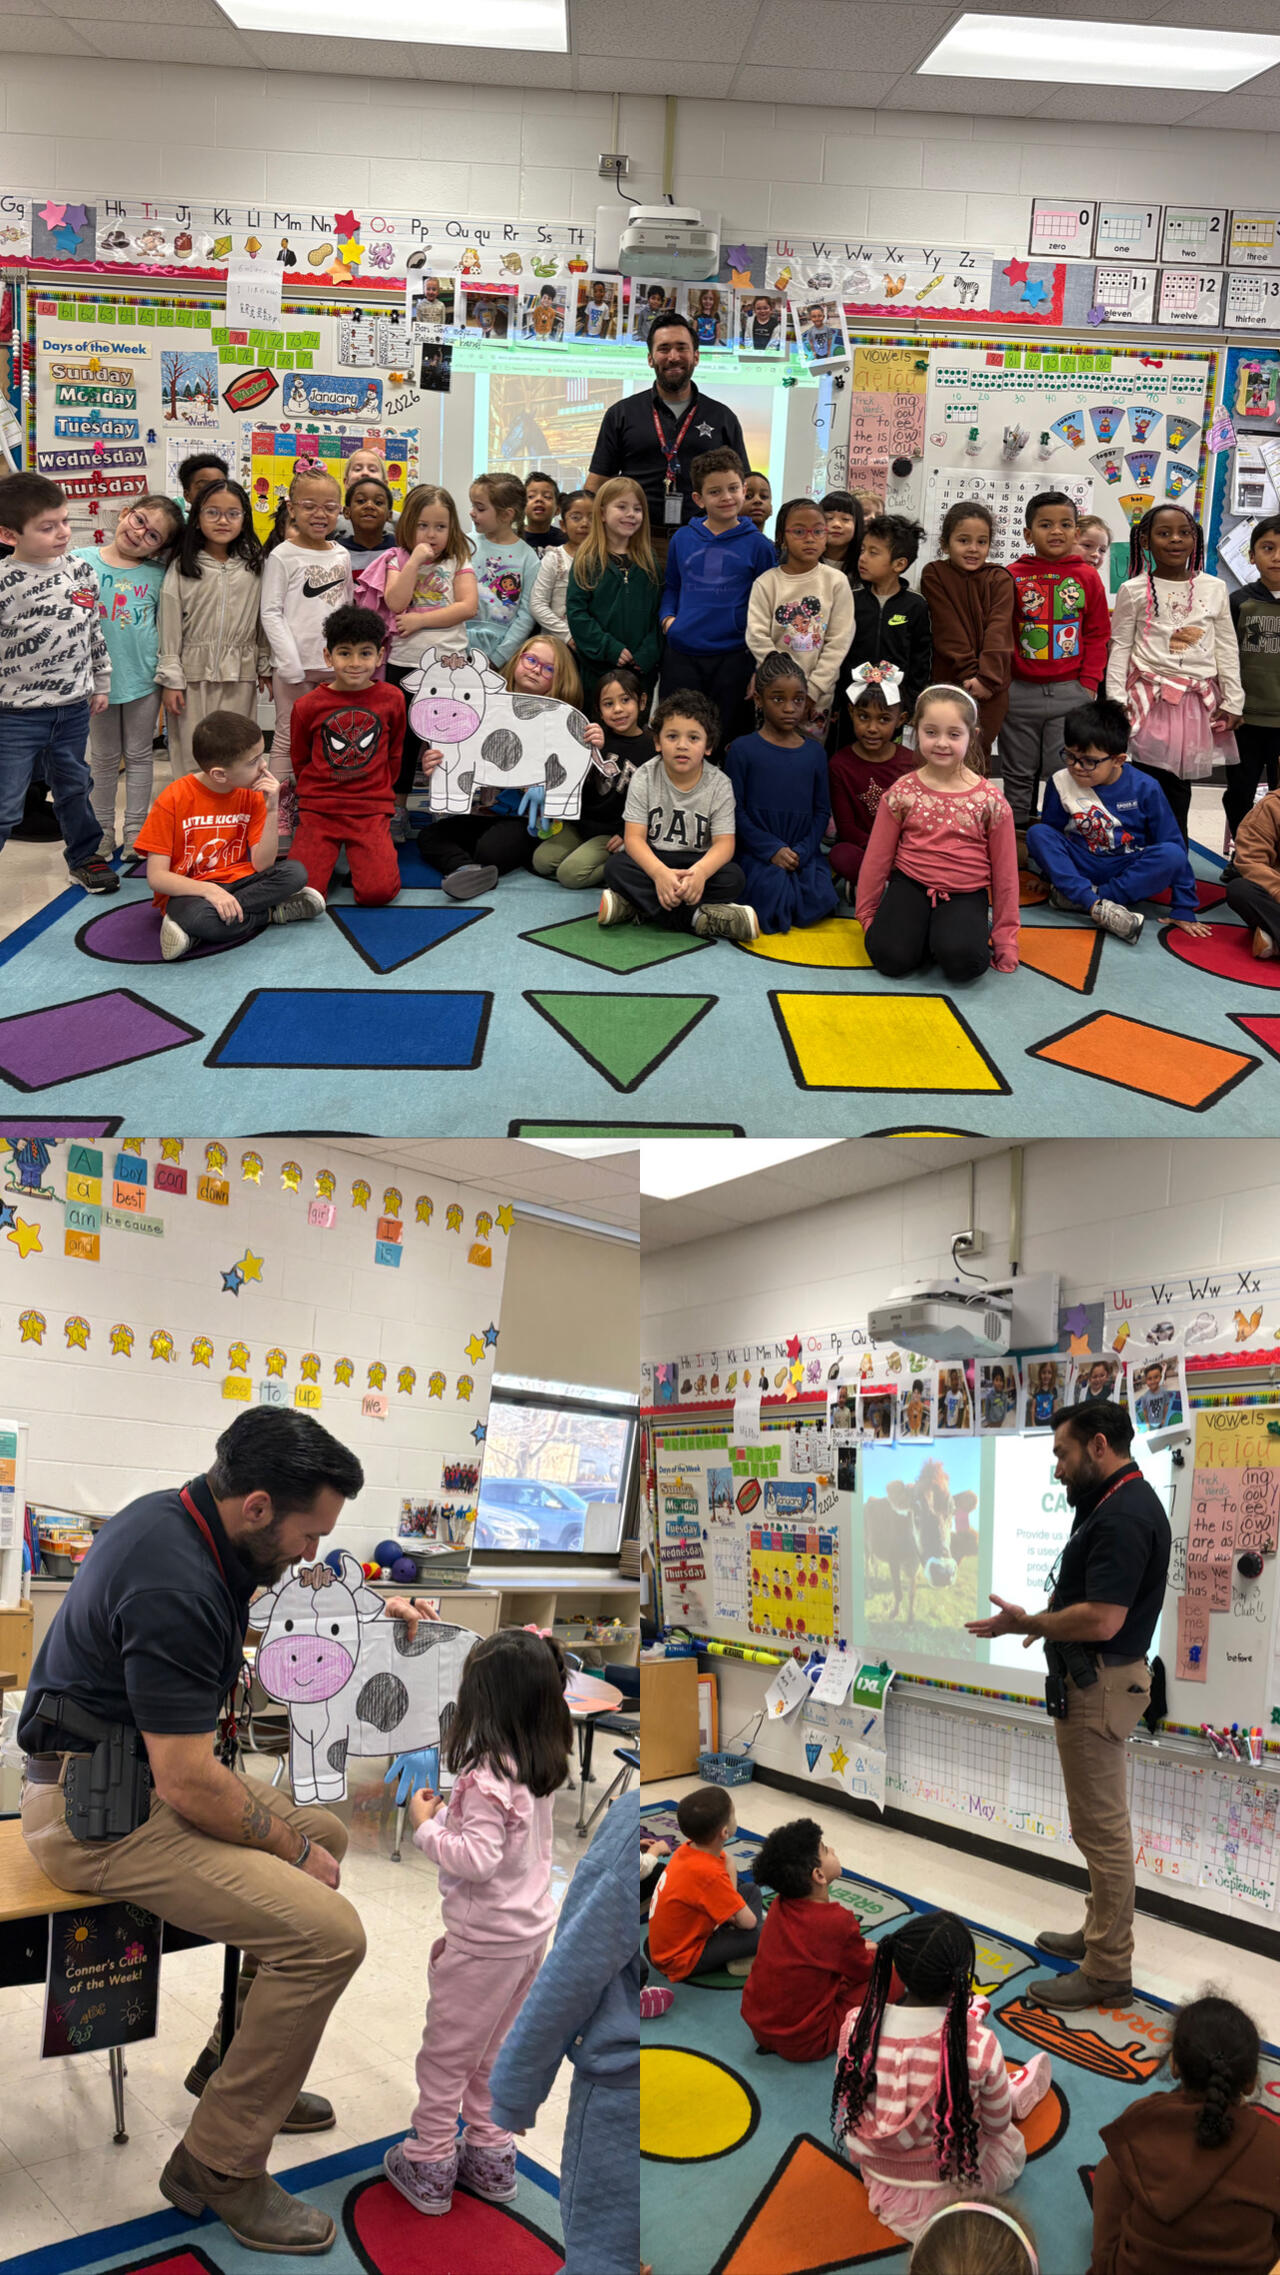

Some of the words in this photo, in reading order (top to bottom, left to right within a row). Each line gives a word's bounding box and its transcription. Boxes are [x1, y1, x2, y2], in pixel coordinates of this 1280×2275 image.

[1, 196, 24, 220] Gg
[106, 200, 126, 217] Hh
[141, 203, 157, 219] Ii
[176, 205, 191, 230] Jj
[214, 208, 232, 225] Kk
[248, 211, 260, 228] Ll
[274, 213, 302, 230] Mm
[312, 215, 331, 232] Nn
[1079, 210, 1090, 226] 0
[1146, 213, 1153, 228] 1
[370, 216, 395, 234] Oo
[411, 218, 429, 242] Pp
[503, 224, 519, 241] Rr
[537, 226, 552, 243] Ss
[568, 228, 585, 245] Tt
[1209, 217, 1220, 232] 2
[1048, 242, 1067, 250] zero
[776, 240, 794, 257] Uu
[812, 242, 831, 259] Vv
[845, 244, 872, 260] Ww
[885, 247, 904, 263] Xx
[922, 249, 941, 272] Yy
[959, 252, 975, 268] Zz
[1247, 252, 1268, 261] three
[1132, 277, 1147, 291] 11
[1199, 278, 1216, 293] 12
[1263, 282, 1280, 297] 13
[1104, 310, 1132, 318] eleven
[1170, 312, 1198, 320] twelve
[1235, 315, 1267, 324] thirteen
[43, 341, 73, 352] Days
[75, 341, 89, 351] of
[90, 343, 110, 352] the
[111, 343, 146, 354] Week
[52, 365, 132, 386] Sunday
[60, 388, 135, 408] Moday
[232, 379, 268, 402] Winter
[309, 389, 358, 407] January
[385, 389, 420, 416] 2026
[1135, 408, 1155, 417] windy
[187, 415, 217, 427] Winter
[856, 418, 864, 426] a
[876, 415, 890, 427] to
[1057, 414, 1076, 427] sunny
[1173, 417, 1191, 428] rainy
[58, 419, 135, 438] Tuesday
[854, 431, 873, 442] the
[853, 446, 873, 456] are
[877, 445, 888, 454] as
[1096, 450, 1116, 461] foggy
[1131, 453, 1154, 461] snowy
[38, 450, 145, 468] Wednesday
[851, 455, 868, 465] and
[851, 468, 866, 480] his
[1172, 464, 1195, 478] cloudy
[57, 479, 146, 496] hursday
[956, 491, 964, 499] 12
[74, 1149, 92, 1172] A
[120, 1160, 142, 1183] boy
[158, 1171, 184, 1190] can
[77, 1181, 91, 1197] a
[200, 1184, 229, 1203] down
[116, 1190, 145, 1209] best
[69, 1209, 96, 1227] am
[106, 1213, 164, 1234] because
[311, 1208, 330, 1225] girl
[383, 1222, 395, 1240] I
[69, 1235, 93, 1253] and
[379, 1247, 393, 1263] is
[1113, 1289, 1132, 1310] Uu
[1152, 1284, 1173, 1304] Vv
[1188, 1277, 1221, 1300] Ww
[1237, 1271, 1260, 1294] Xx
[807, 1336, 822, 1352] Oo
[831, 1333, 842, 1355] Pp
[756, 1346, 771, 1360] Mm
[264, 1382, 281, 1400] to
[298, 1390, 316, 1405] up
[818, 1493, 839, 1515] 2026
[1197, 1502, 1206, 1512] a
[1221, 1498, 1237, 1512] to
[1245, 1503, 1263, 1513] ee
[666, 1523, 698, 1536] Tuesday
[1194, 1518, 1216, 1532] the
[1017, 1528, 1050, 1541] Provide
[1192, 1536, 1215, 1547] are
[1221, 1537, 1233, 1547] as
[661, 1545, 701, 1559] Wednesday
[1188, 1549, 1209, 1562] and
[665, 1567, 705, 1579] Thursday
[1188, 1568, 1207, 1580] his
[1188, 1586, 1207, 1596] has
[1214, 1581, 1227, 1593] he
[1185, 1602, 1202, 1616] be
[1182, 1631, 1205, 1646] they
[1227, 1653, 1252, 1662] before
[857, 1677, 880, 1693] IXL
[969, 1795, 995, 1821] May
[1015, 1811, 1056, 1836] June
[1215, 1869, 1271, 1900] September
[66, 1958, 115, 1978] Conner's
[119, 1954, 148, 1969] Cutie
[975, 1944, 1015, 1975] YEL
[69, 1981, 84, 1994] of
[86, 1978, 105, 1990] the
[109, 1970, 143, 1986] Week!
